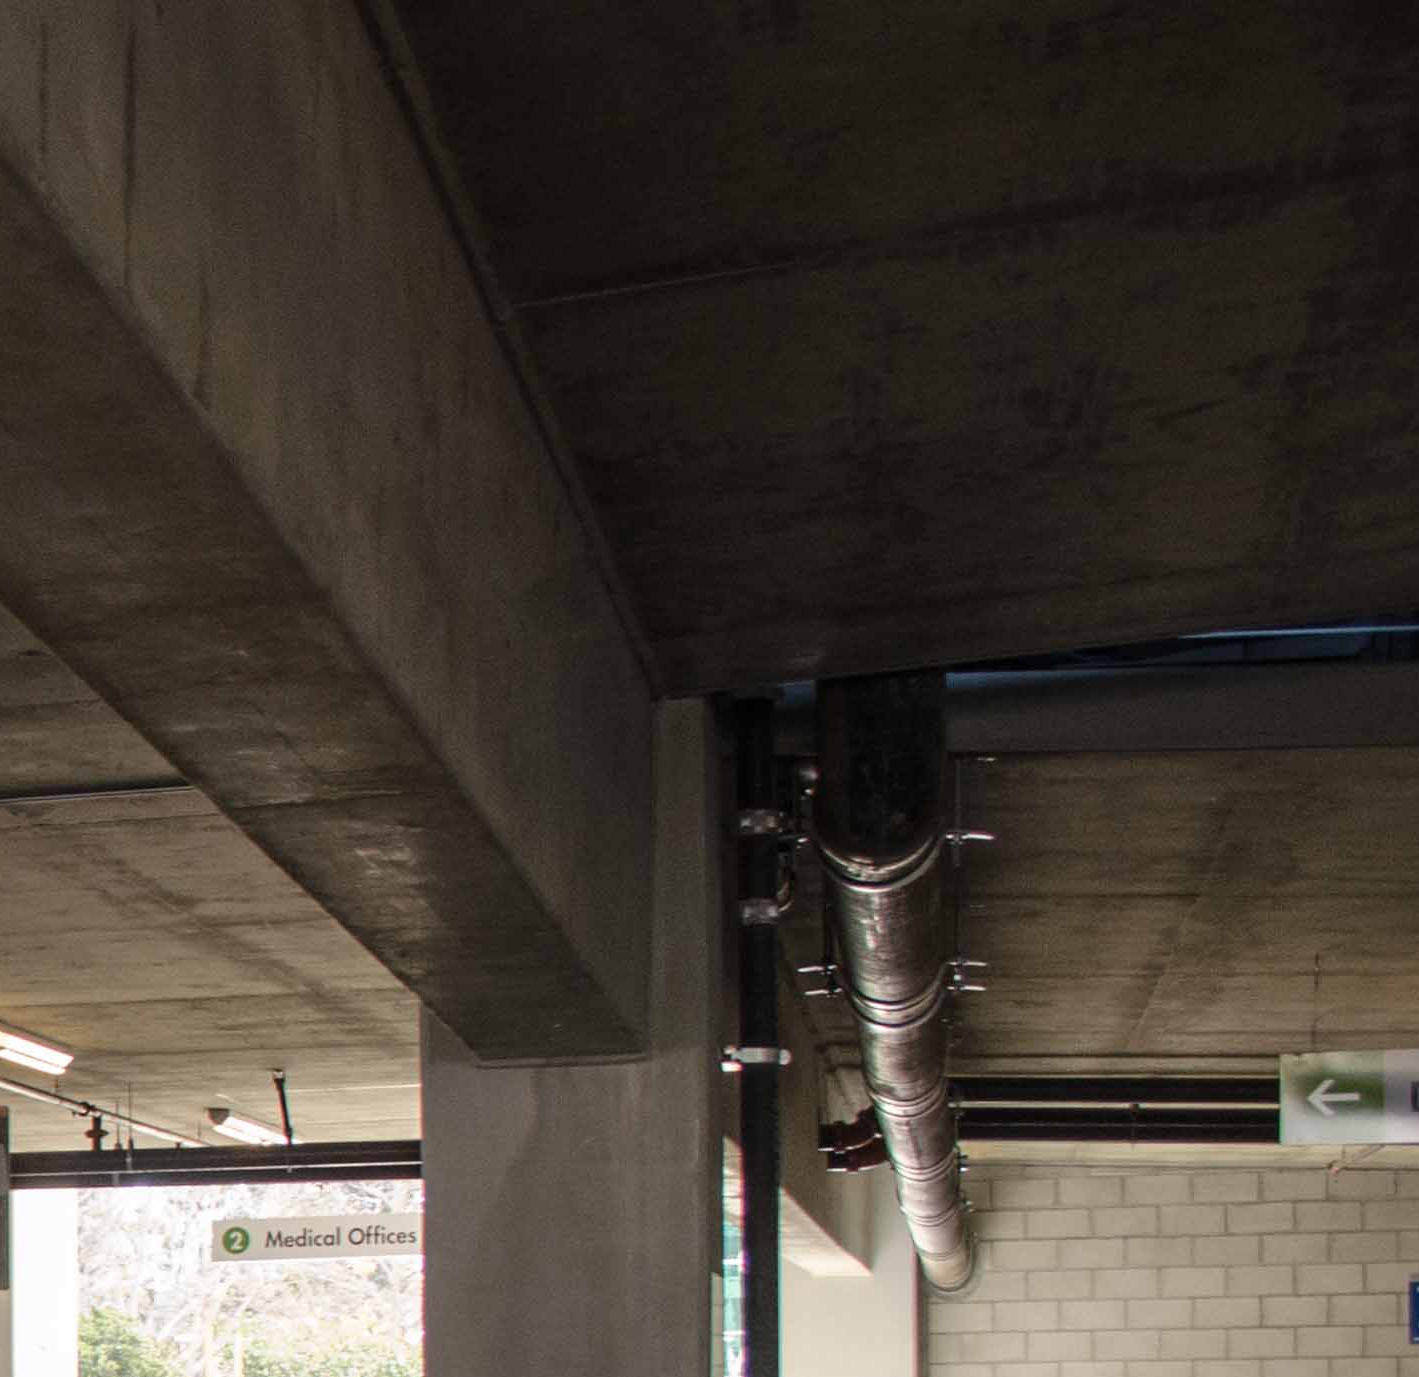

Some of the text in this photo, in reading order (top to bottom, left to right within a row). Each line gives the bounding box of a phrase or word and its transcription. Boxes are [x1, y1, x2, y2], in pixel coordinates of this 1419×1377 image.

[229, 1224, 417, 1249] 2 Medical Offices
